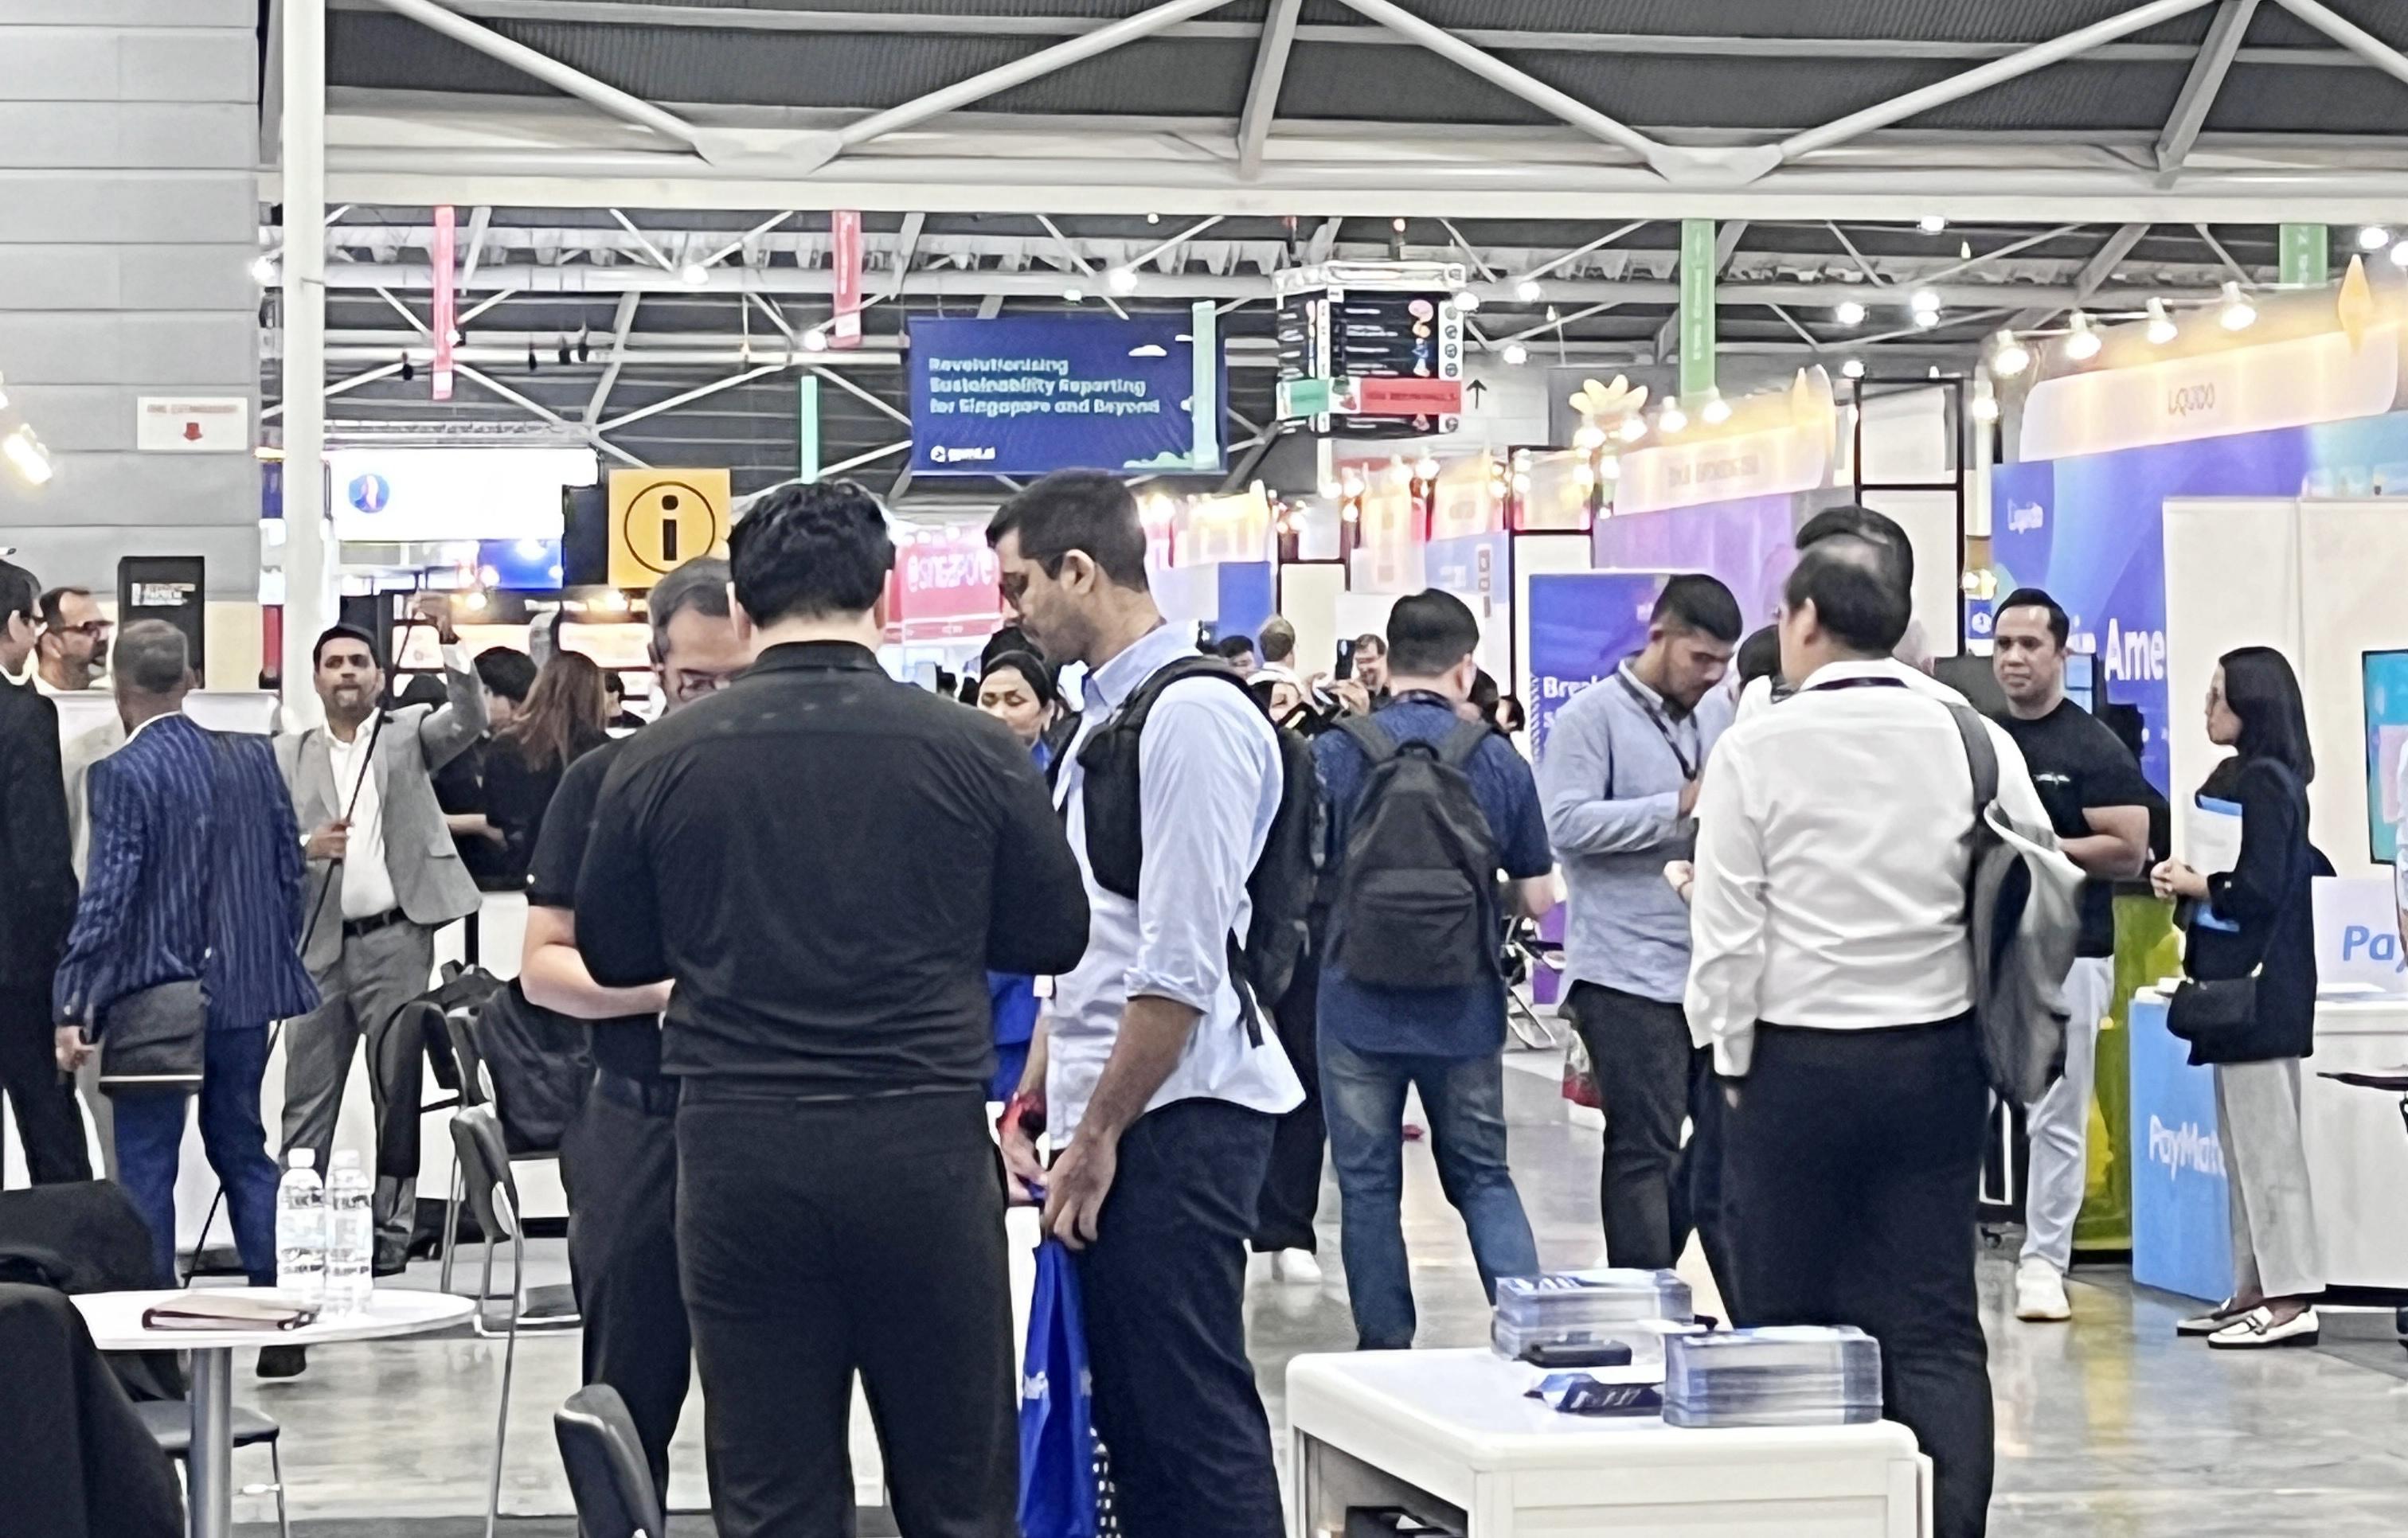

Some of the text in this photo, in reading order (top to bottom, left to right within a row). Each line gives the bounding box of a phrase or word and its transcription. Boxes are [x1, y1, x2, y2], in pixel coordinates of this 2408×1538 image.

[929, 377, 1147, 396] Sustainability Reporting
[929, 397, 1160, 417] for Singapore and Beyond
